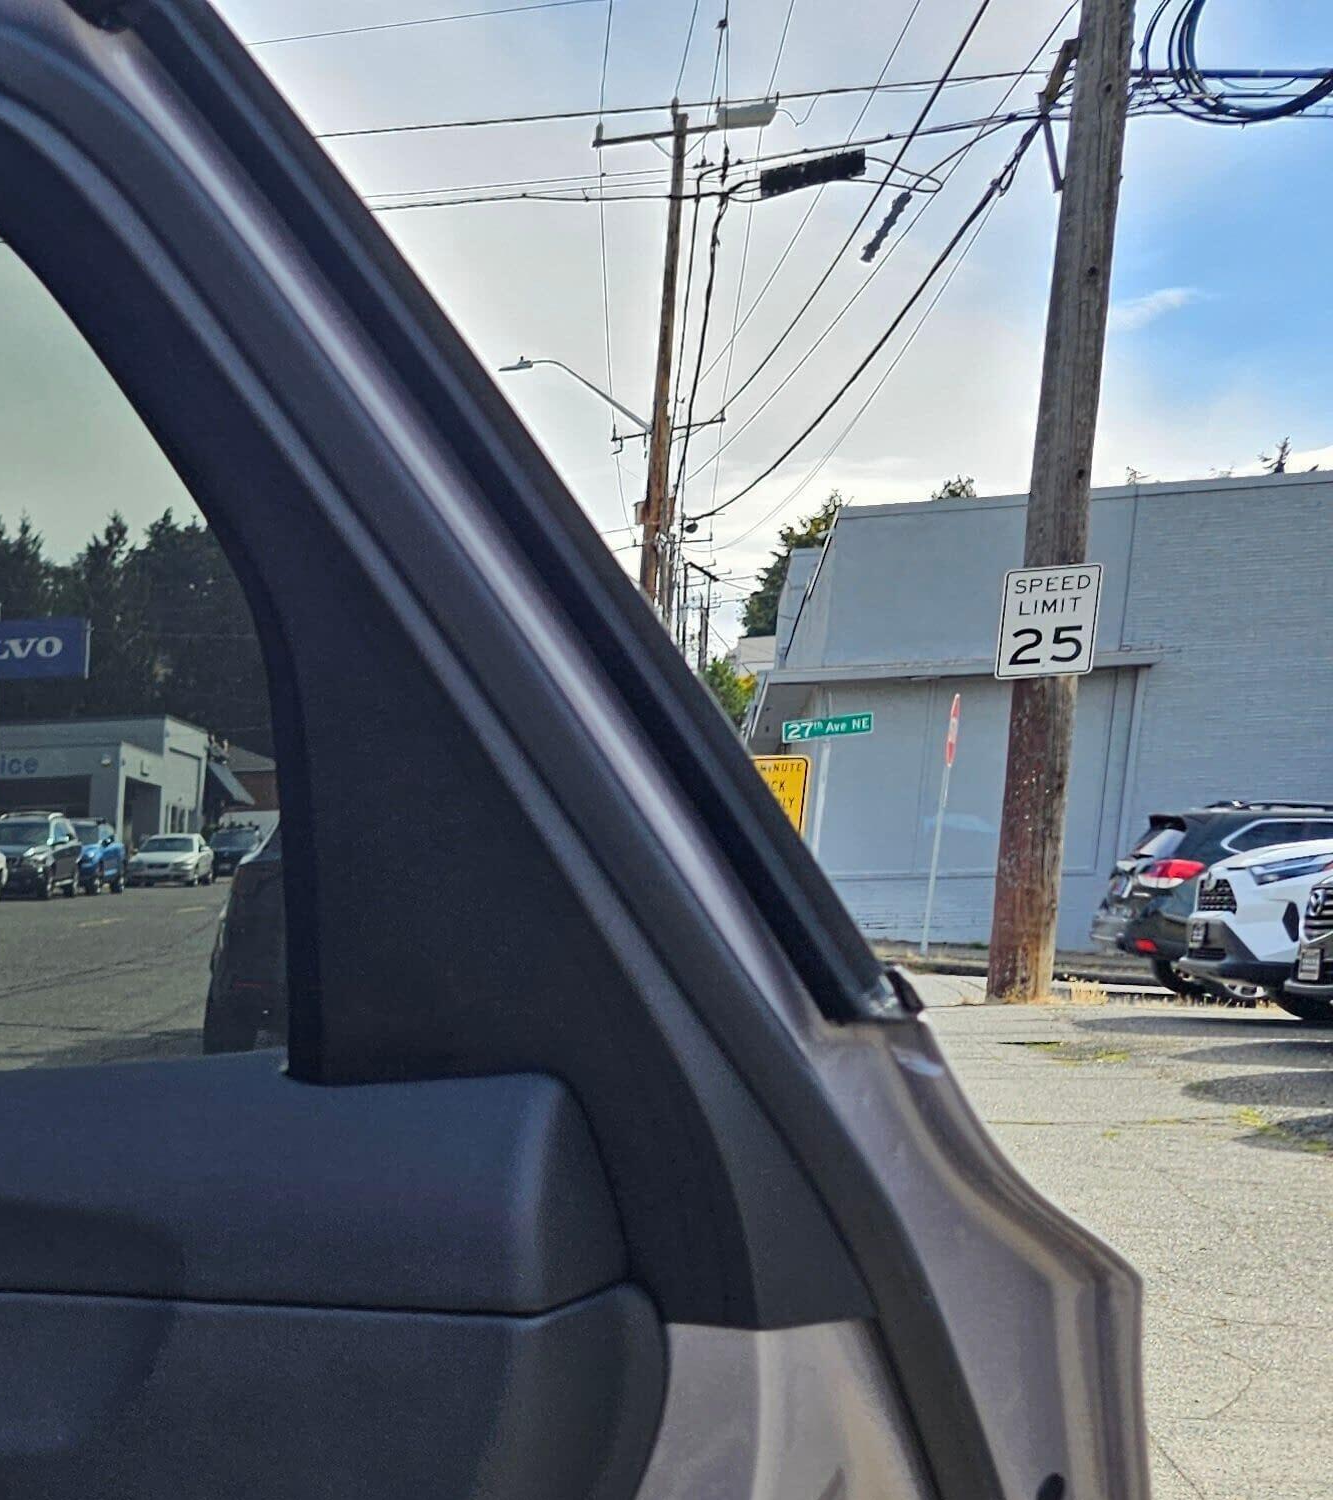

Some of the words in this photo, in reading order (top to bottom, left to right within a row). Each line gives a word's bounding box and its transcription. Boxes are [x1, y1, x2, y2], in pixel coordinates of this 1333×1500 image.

[1014, 574, 1092, 595] SPEED
[1018, 596, 1082, 616] LIMIT
[1008, 624, 1084, 666] 25
[825, 721, 847, 733] Ave
[852, 717, 870, 729] NE
